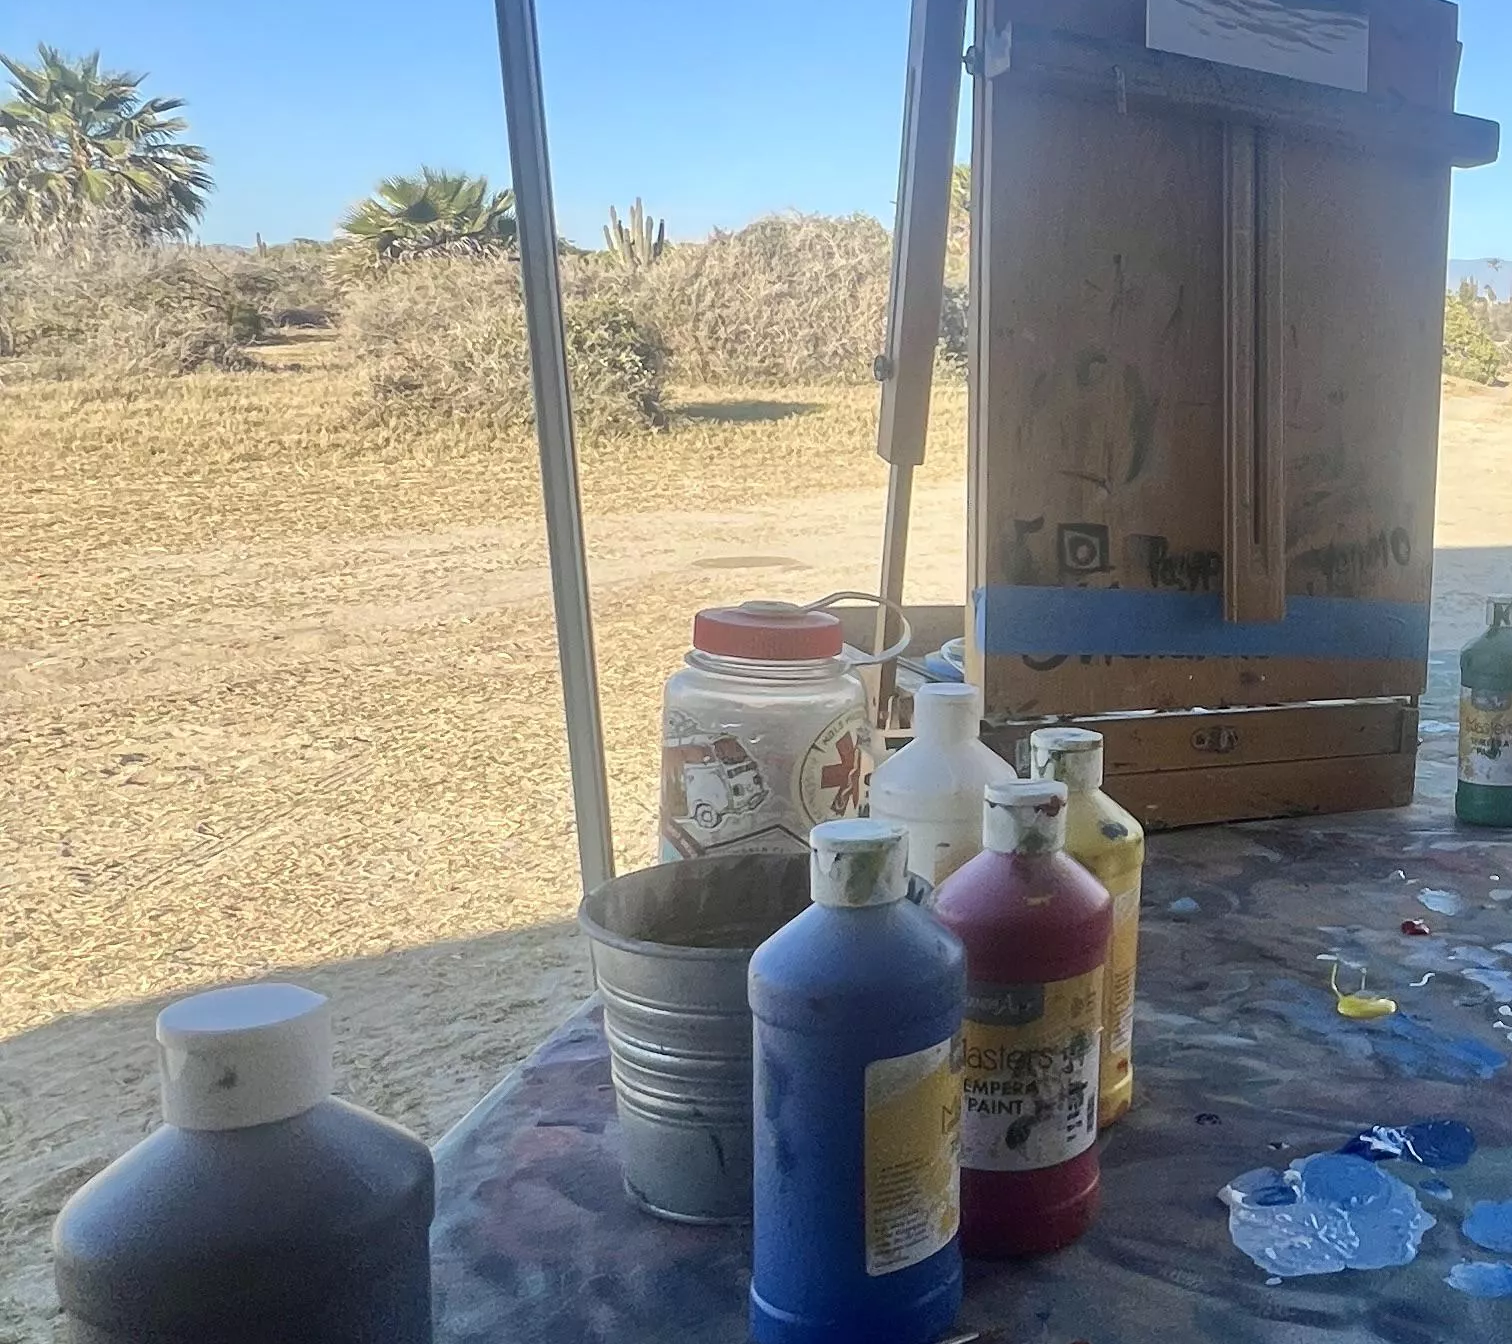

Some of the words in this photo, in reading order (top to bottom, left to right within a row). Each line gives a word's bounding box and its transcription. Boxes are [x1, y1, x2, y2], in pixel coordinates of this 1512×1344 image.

[962, 1038, 1053, 1073] asters
[963, 1078, 1040, 1096] EMPERA
[967, 1097, 1024, 1115] PAINT
